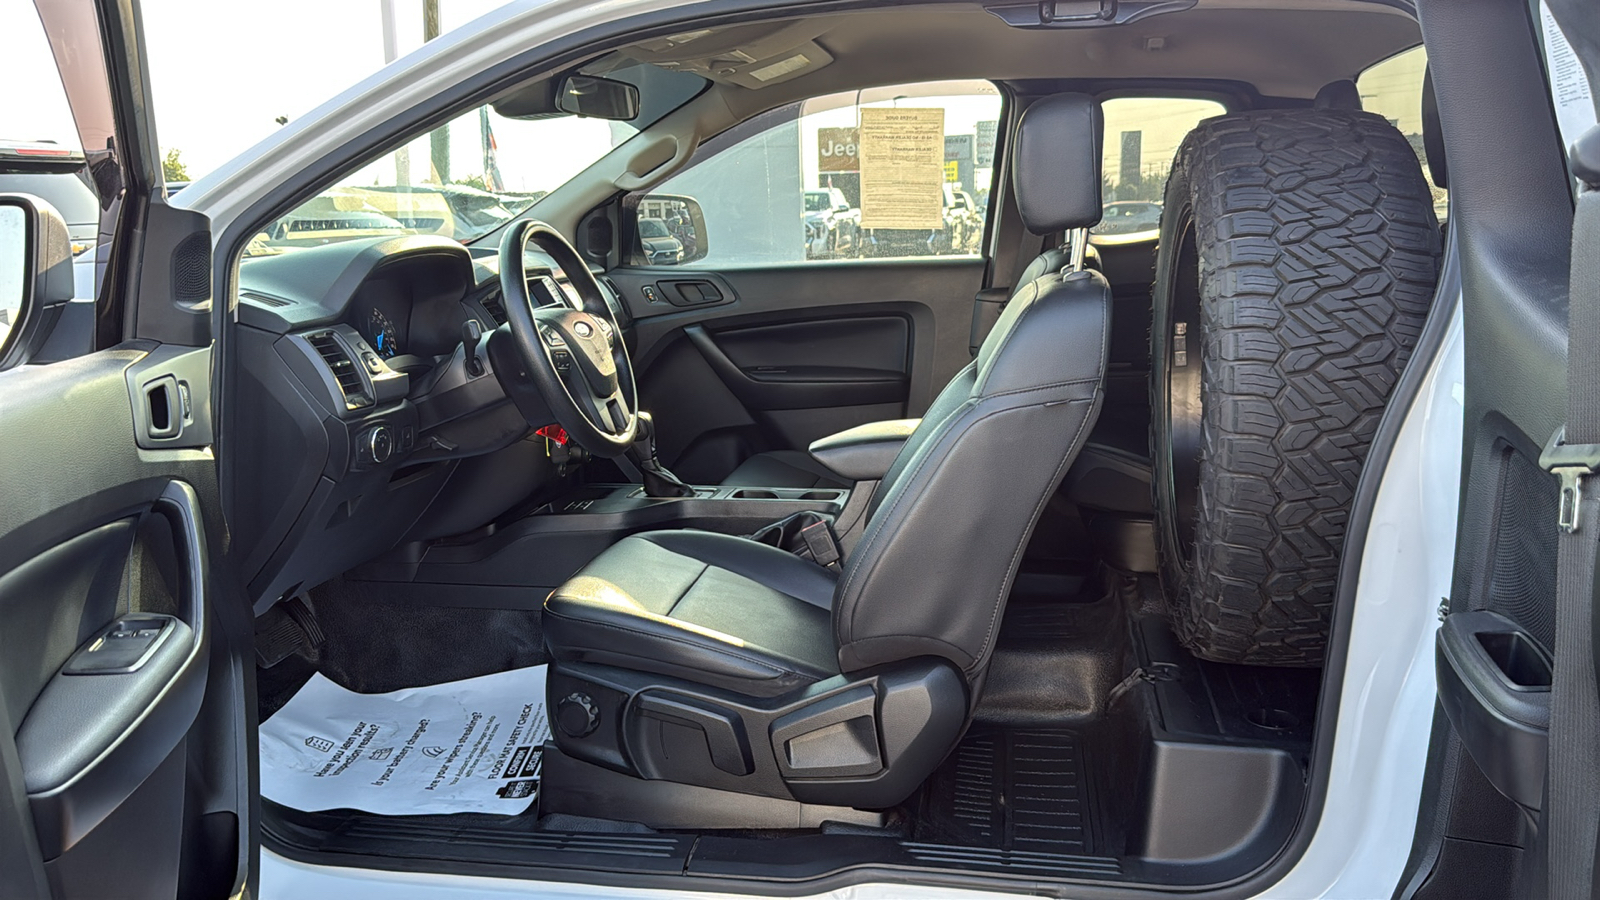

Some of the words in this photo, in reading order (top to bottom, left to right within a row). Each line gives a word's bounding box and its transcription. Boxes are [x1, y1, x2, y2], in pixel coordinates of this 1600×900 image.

[517, 703, 533, 725] CHECK
[405, 719, 430, 745] charged?
[506, 726, 524, 747] SAFETY
[313, 763, 335, 777] Have
[329, 749, 345, 763] you
[340, 736, 357, 751] seen
[351, 721, 367, 737] your
[328, 749, 363, 776] inspection
[357, 724, 380, 749] results?
[386, 745, 413, 767] battery
[424, 780, 440, 790] Are
[434, 764, 449, 779] your
[444, 744, 463, 764] wipers
[458, 712, 482, 743] streaking?
[500, 746, 514, 759] MAT
[488, 760, 505, 780] FLOOR
[508, 750, 527, 775] CONFIRM
[525, 751, 542, 771] SECURE
[378, 767, 395, 781] your
